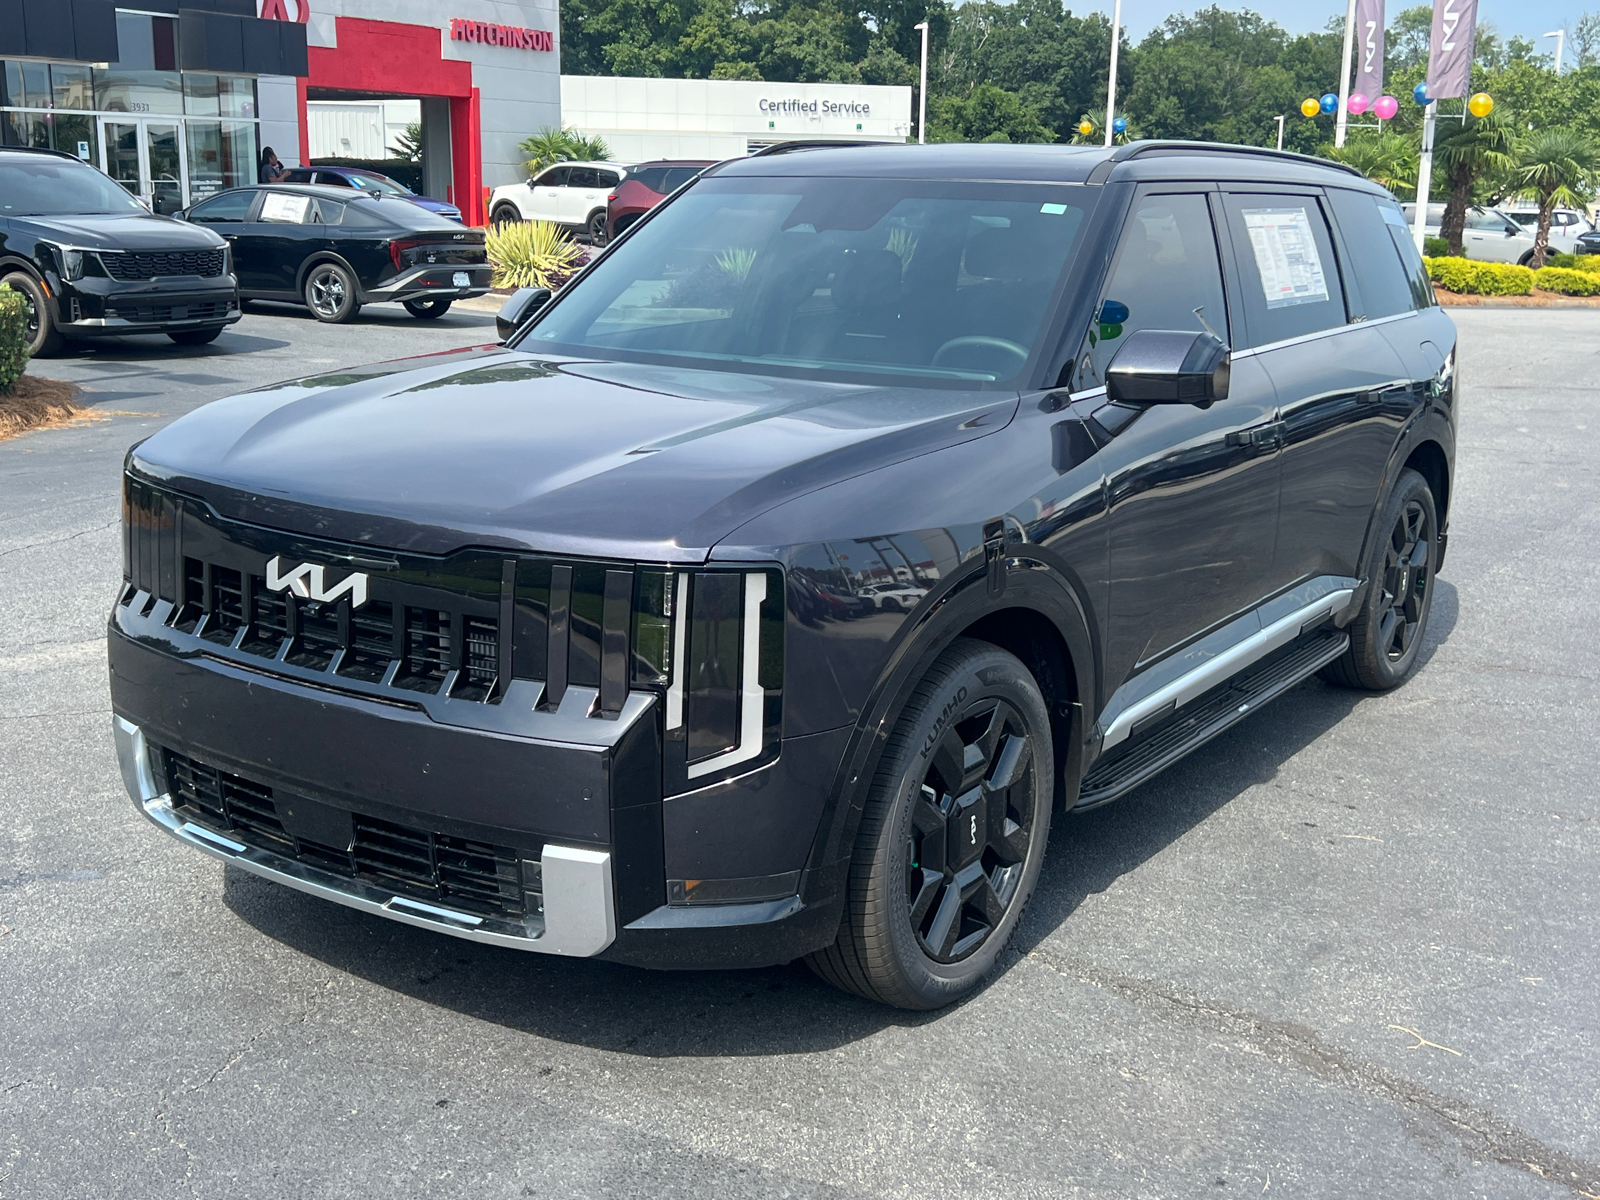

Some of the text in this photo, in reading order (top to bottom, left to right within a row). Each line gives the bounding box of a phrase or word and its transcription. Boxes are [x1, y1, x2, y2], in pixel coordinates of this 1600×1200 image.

[450, 18, 553, 52] HUTCHINSON
[132, 102, 150, 112] 3931
[759, 98, 870, 113] Certified Service
[266, 555, 368, 608] KIA
[919, 685, 968, 760] KUMHO
